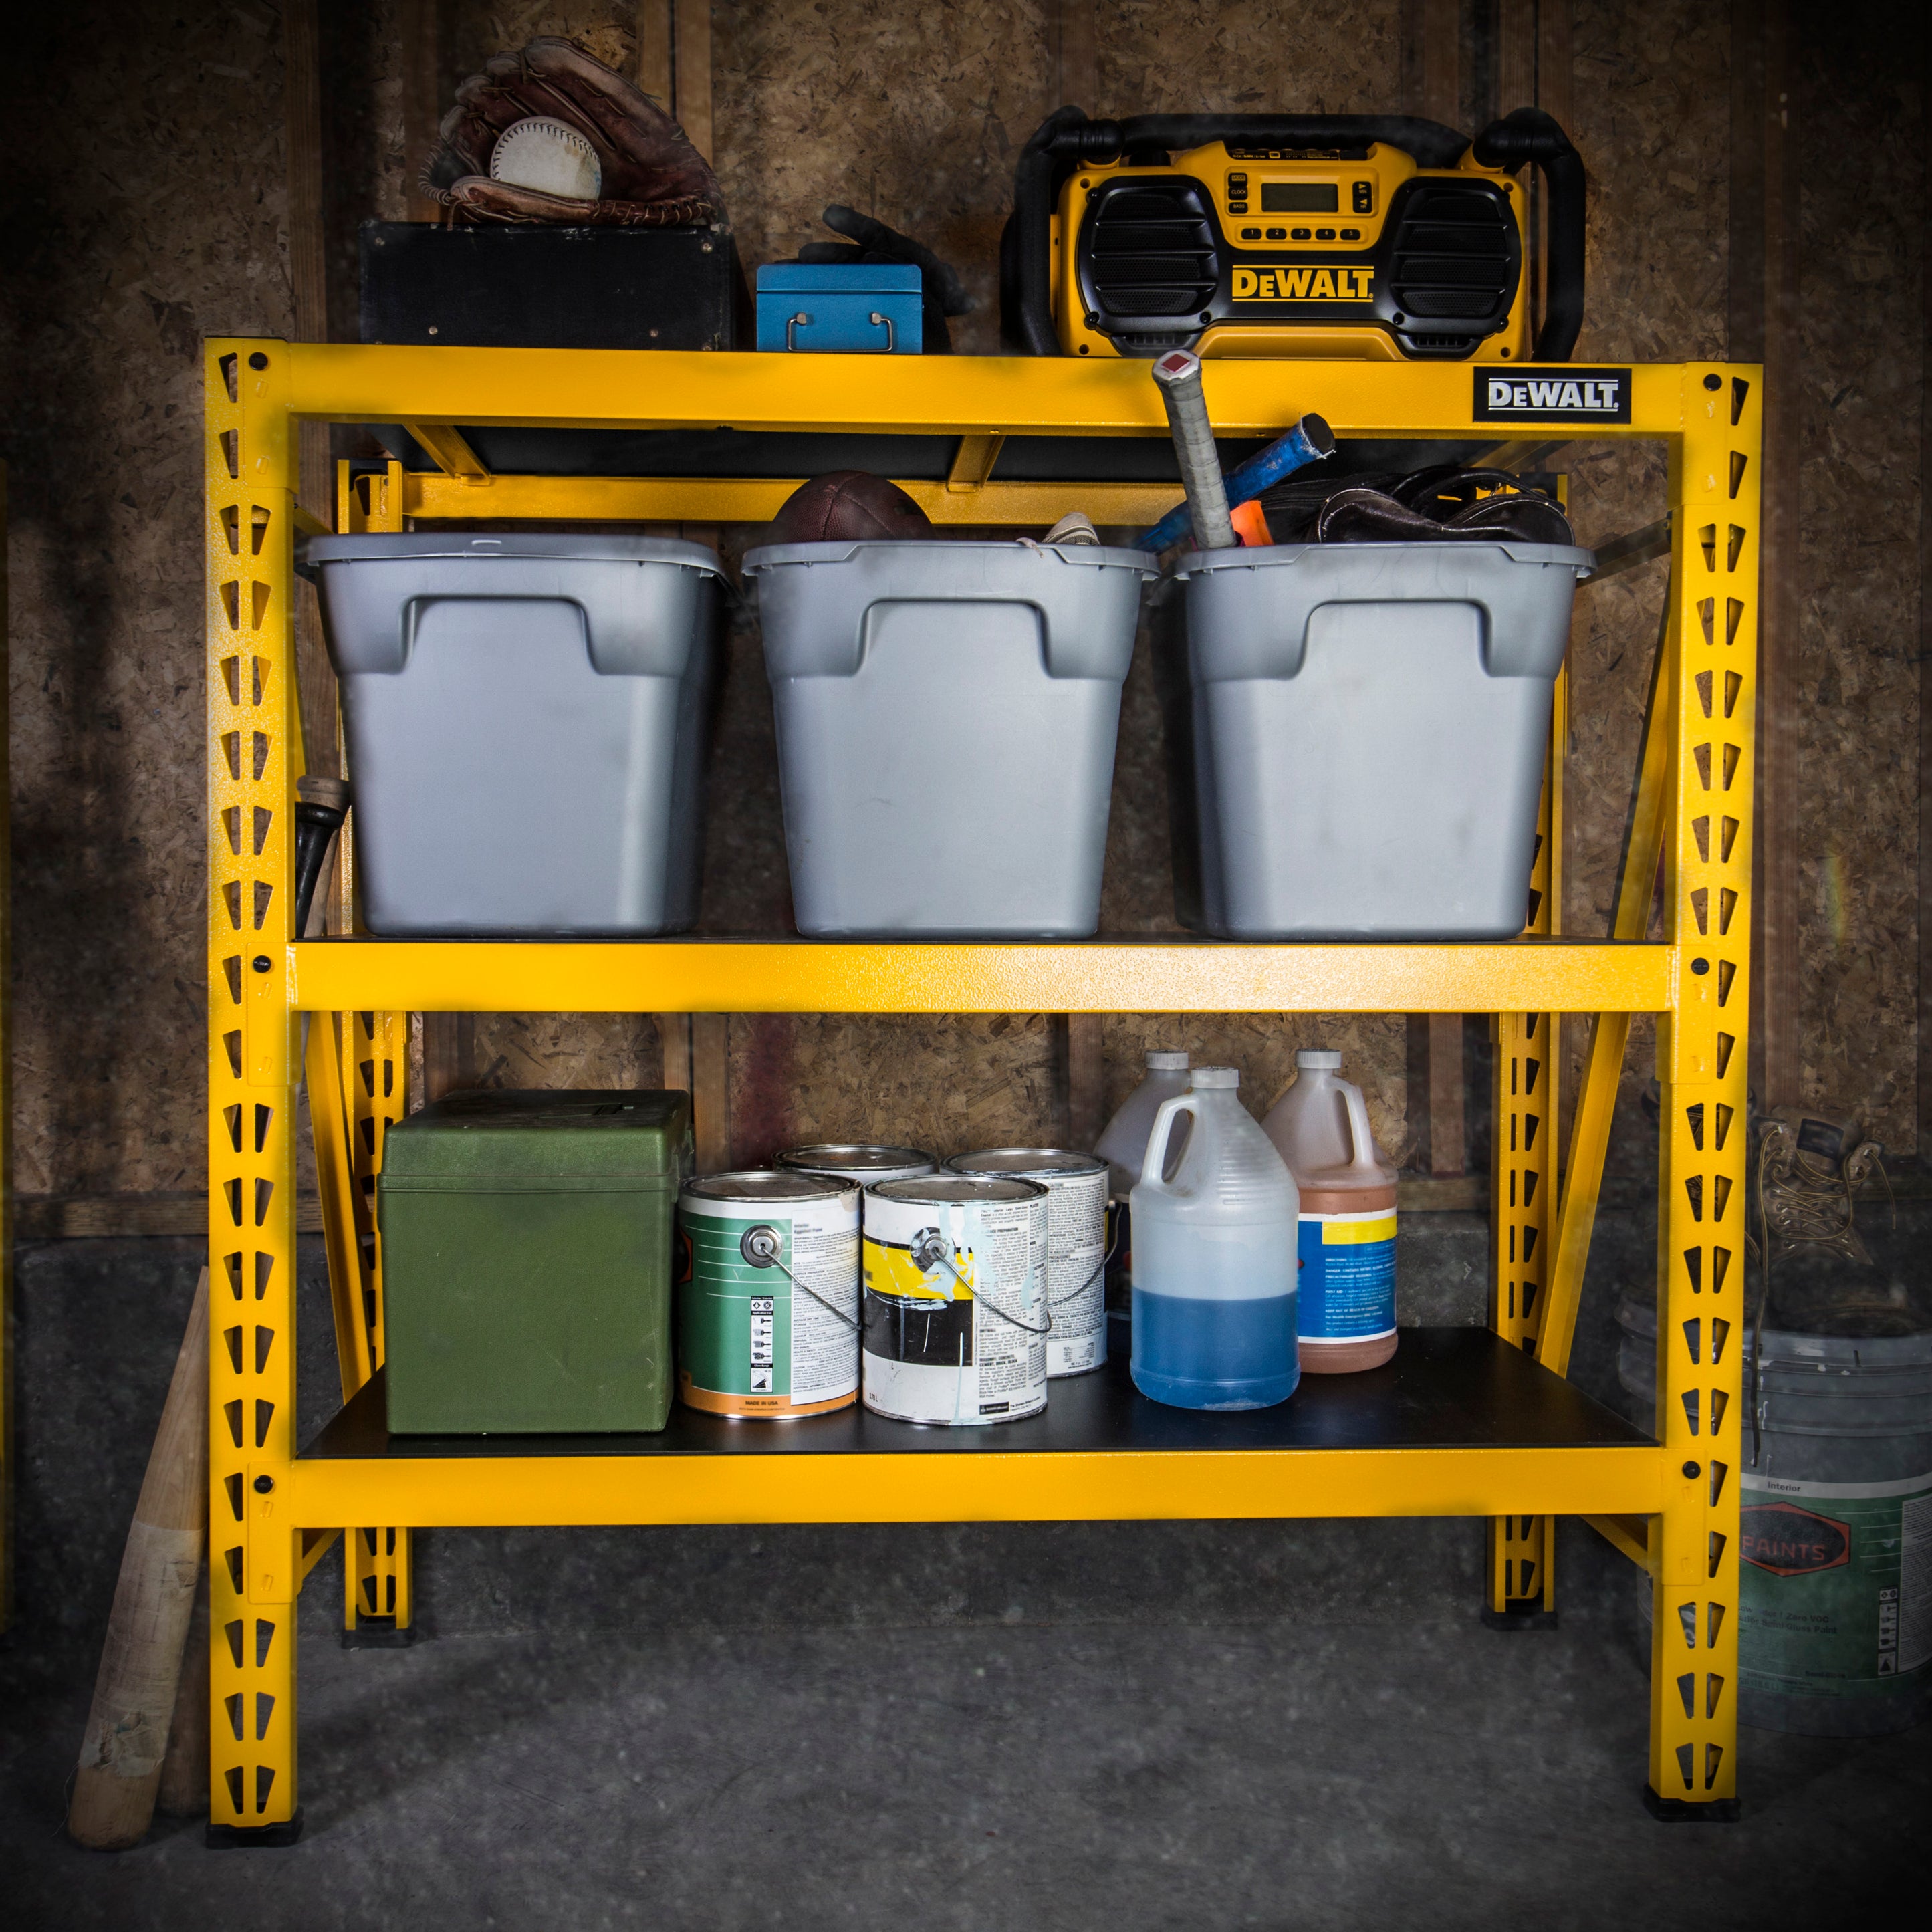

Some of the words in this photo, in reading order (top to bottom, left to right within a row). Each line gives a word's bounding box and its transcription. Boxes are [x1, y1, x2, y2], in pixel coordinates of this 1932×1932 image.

[1768, 1481, 1801, 1492] Interior
[1742, 1536, 1825, 1561] PAINTS
[1786, 1612, 1807, 1621] Zero
[1810, 1614, 1830, 1624] VOC
[1814, 1624, 1838, 1635] Paint
